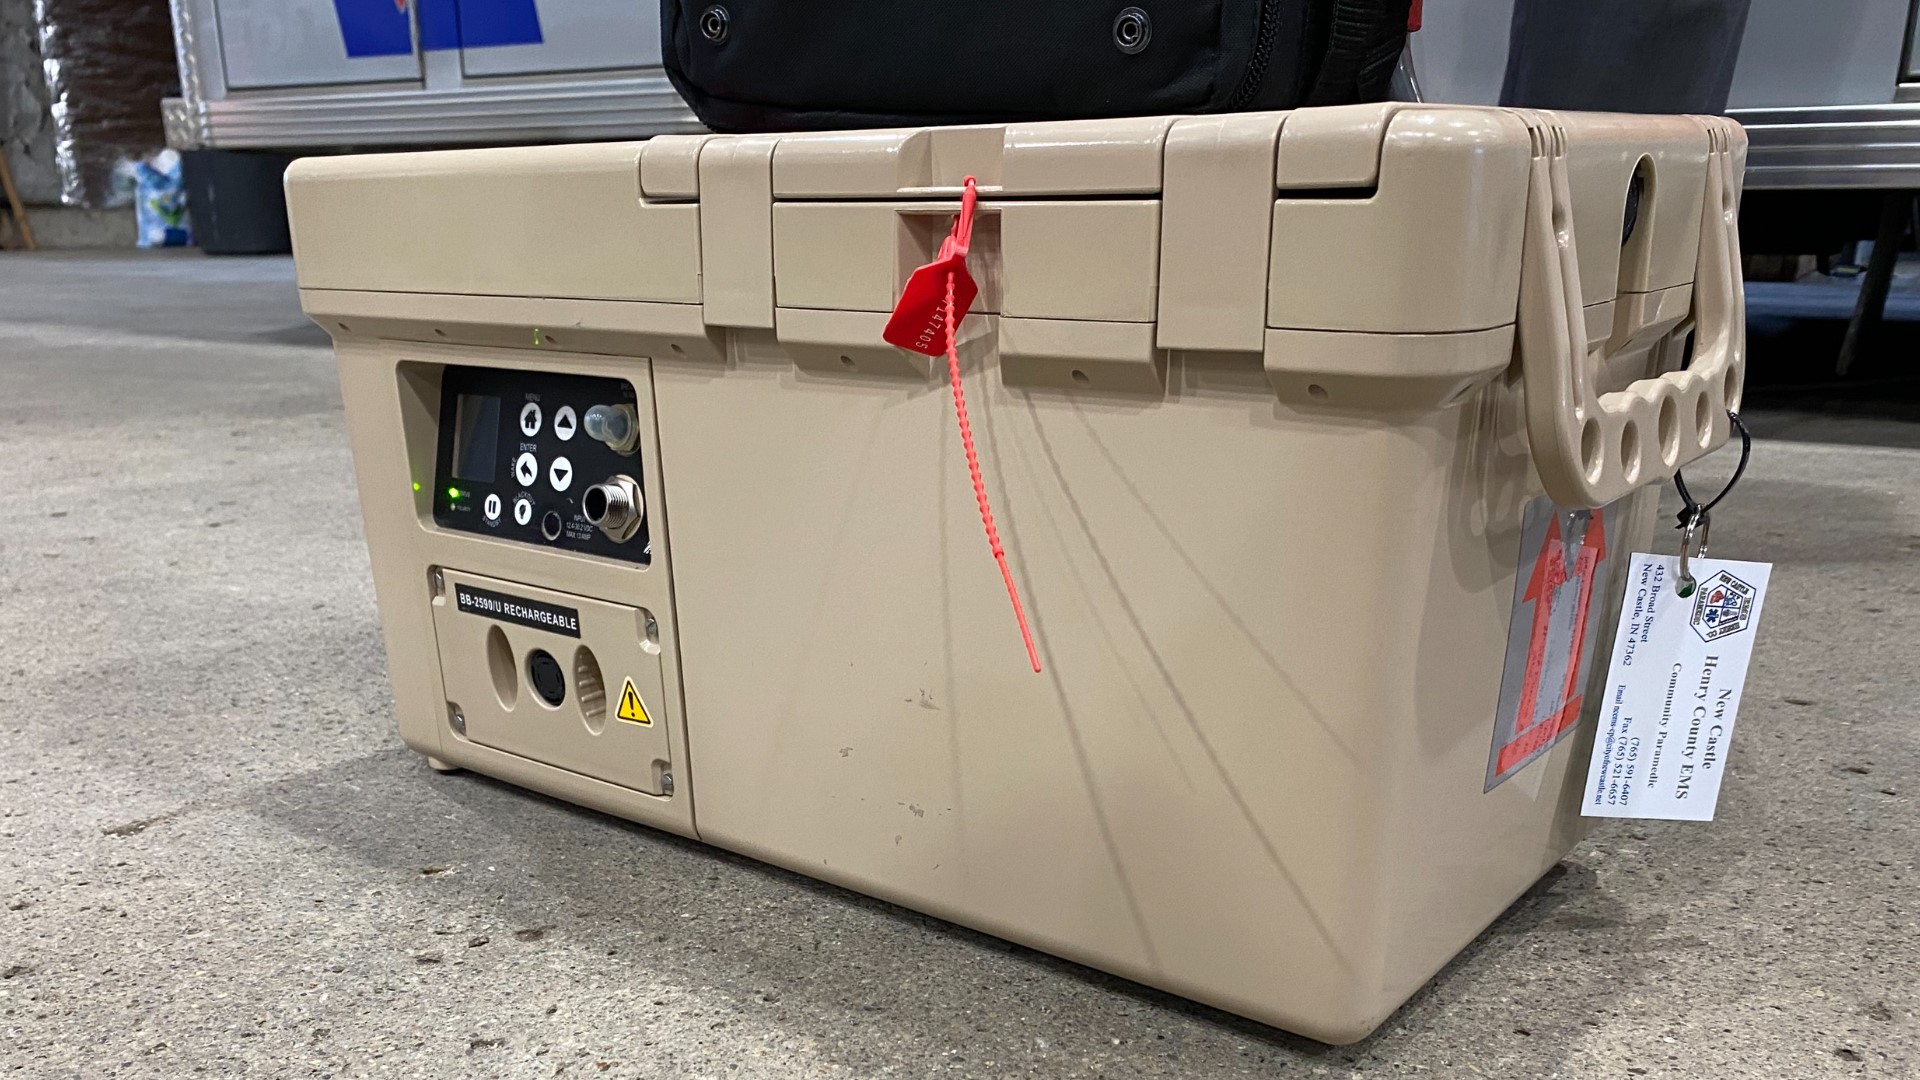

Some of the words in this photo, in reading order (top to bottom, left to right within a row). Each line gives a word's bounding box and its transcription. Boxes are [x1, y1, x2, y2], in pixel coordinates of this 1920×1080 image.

[520, 443, 537, 452] ENTER
[512, 491, 536, 506] BLACKOUT
[1641, 563, 1653, 585] New
[1653, 564, 1665, 583] 432
[459, 593, 502, 612] BB-2590/U
[504, 605, 577, 630] RECHARGEABLE
[1632, 588, 1647, 620] Castle,
[1646, 585, 1661, 613] Broad
[1630, 622, 1641, 635] IN
[1640, 615, 1655, 643] Street
[1622, 637, 1637, 667] 47362
[1694, 655, 1719, 702] Henry
[1614, 685, 1626, 704] Email
[1659, 663, 1682, 727] Community
[1715, 689, 1732, 720] New
[1621, 717, 1632, 734] Fax
[1681, 706, 1707, 759] County
[1614, 737, 1627, 761] (765)
[1627, 737, 1640, 762] (765)
[1648, 731, 1668, 789] Paramedic
[1702, 725, 1723, 770] Castle
[1607, 764, 1622, 806] 521-6657
[1619, 765, 1635, 806] 591-6407
[1675, 764, 1694, 799] EMS
